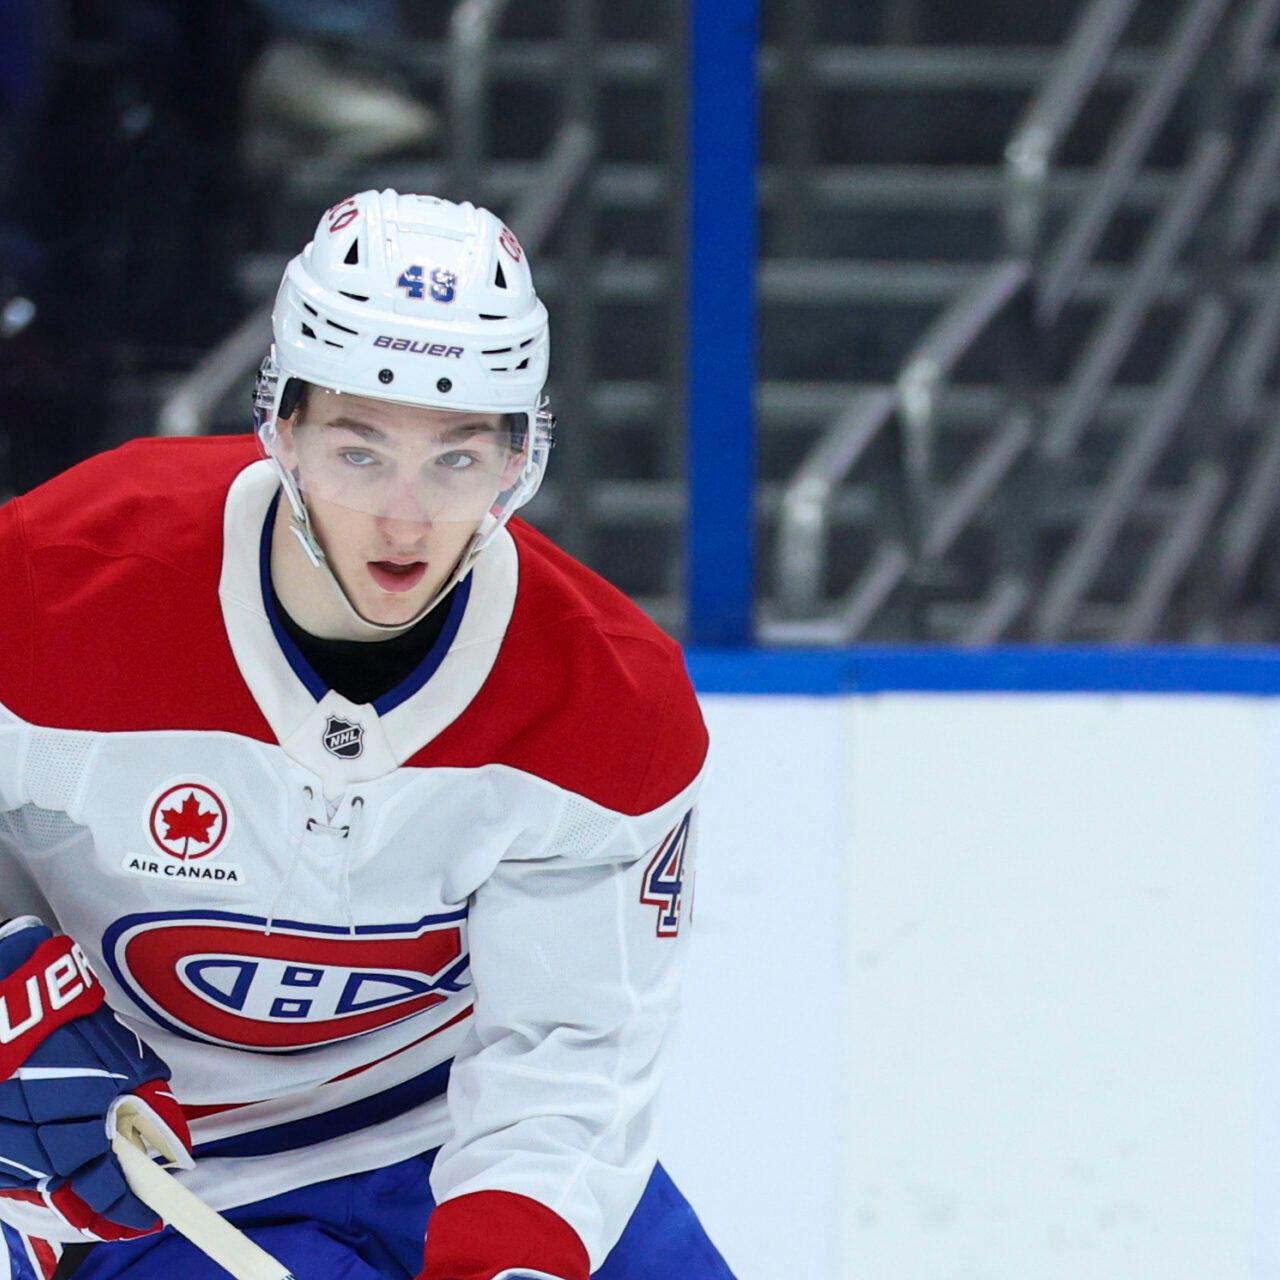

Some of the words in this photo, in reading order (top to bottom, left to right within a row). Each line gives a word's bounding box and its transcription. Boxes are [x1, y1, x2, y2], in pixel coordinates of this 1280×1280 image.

[330, 729, 358, 748] NHL
[129, 858, 159, 874] AIR
[163, 864, 238, 882] CANADA
[639, 806, 696, 938] 4
